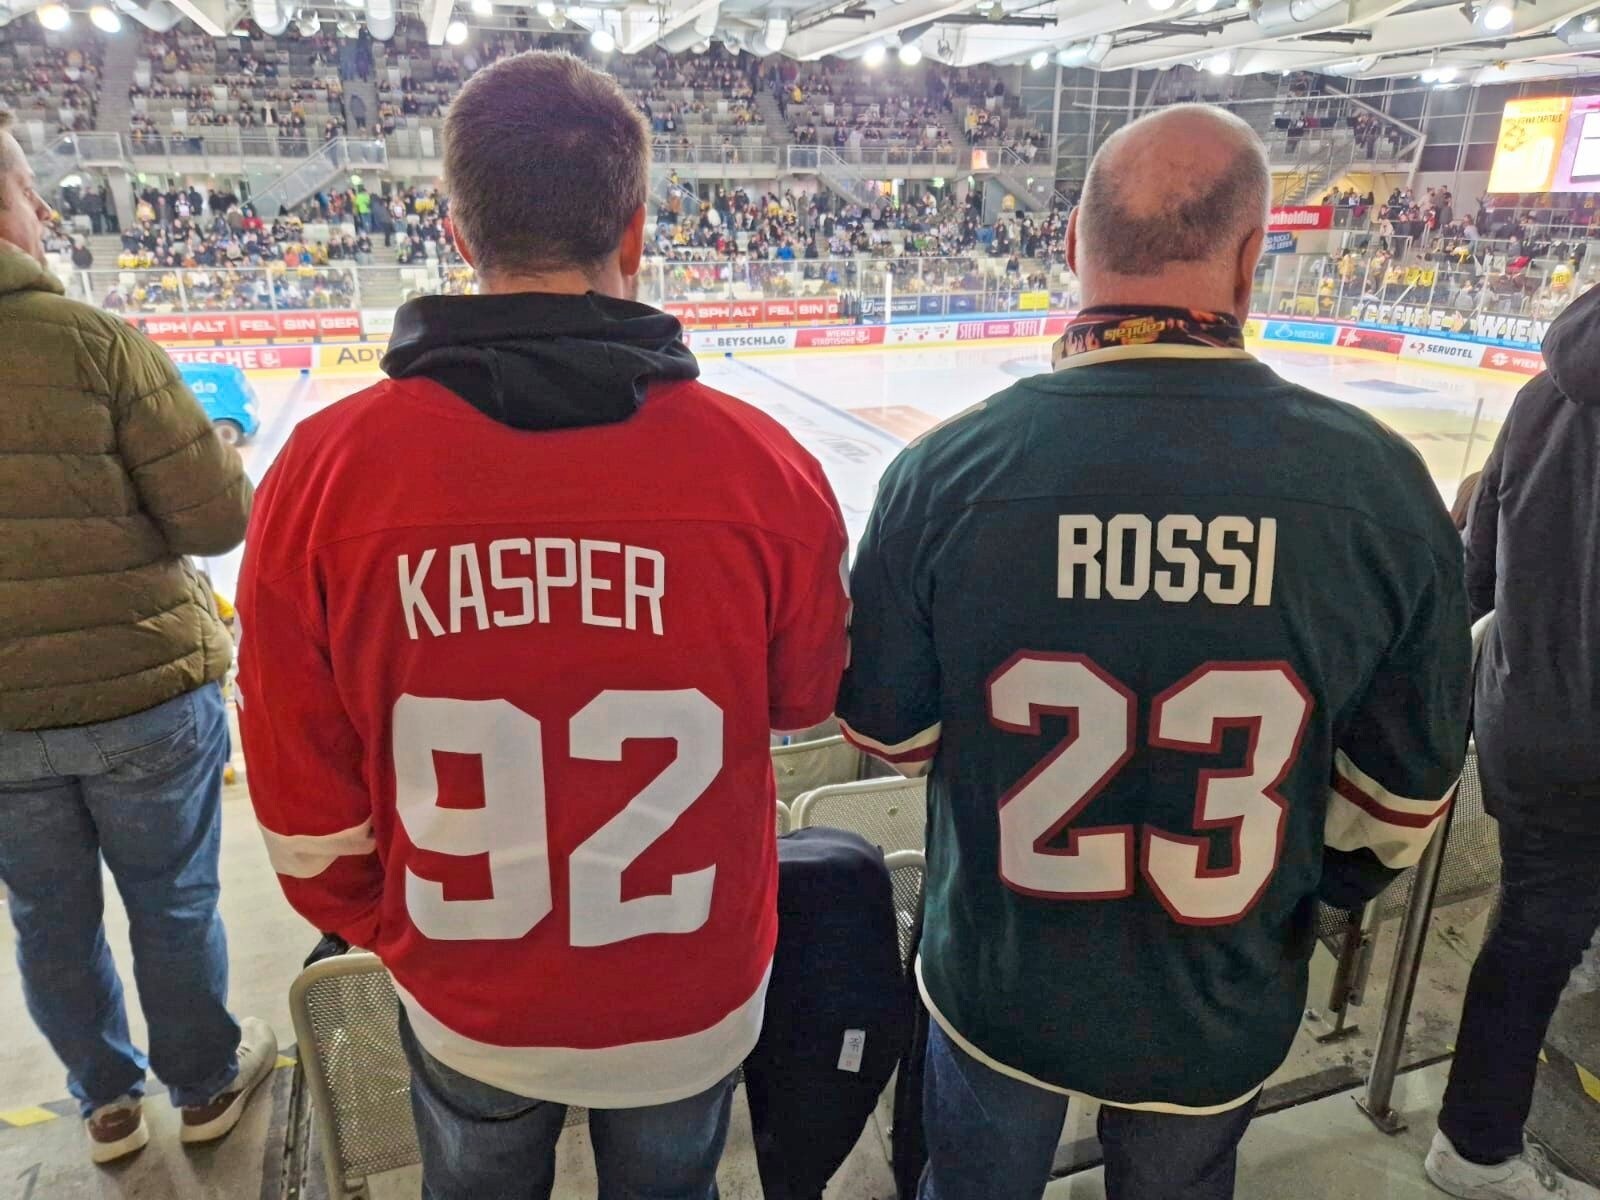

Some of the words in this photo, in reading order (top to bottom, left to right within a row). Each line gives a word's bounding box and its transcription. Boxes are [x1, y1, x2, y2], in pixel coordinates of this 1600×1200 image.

[717, 335, 786, 347] BEYSCHLAG
[1427, 344, 1473, 359] SERVOTEL
[398, 537, 665, 639] KASPER
[1057, 514, 1277, 606] ROSSI
[393, 688, 724, 947] 92
[985, 649, 1316, 927] 23
